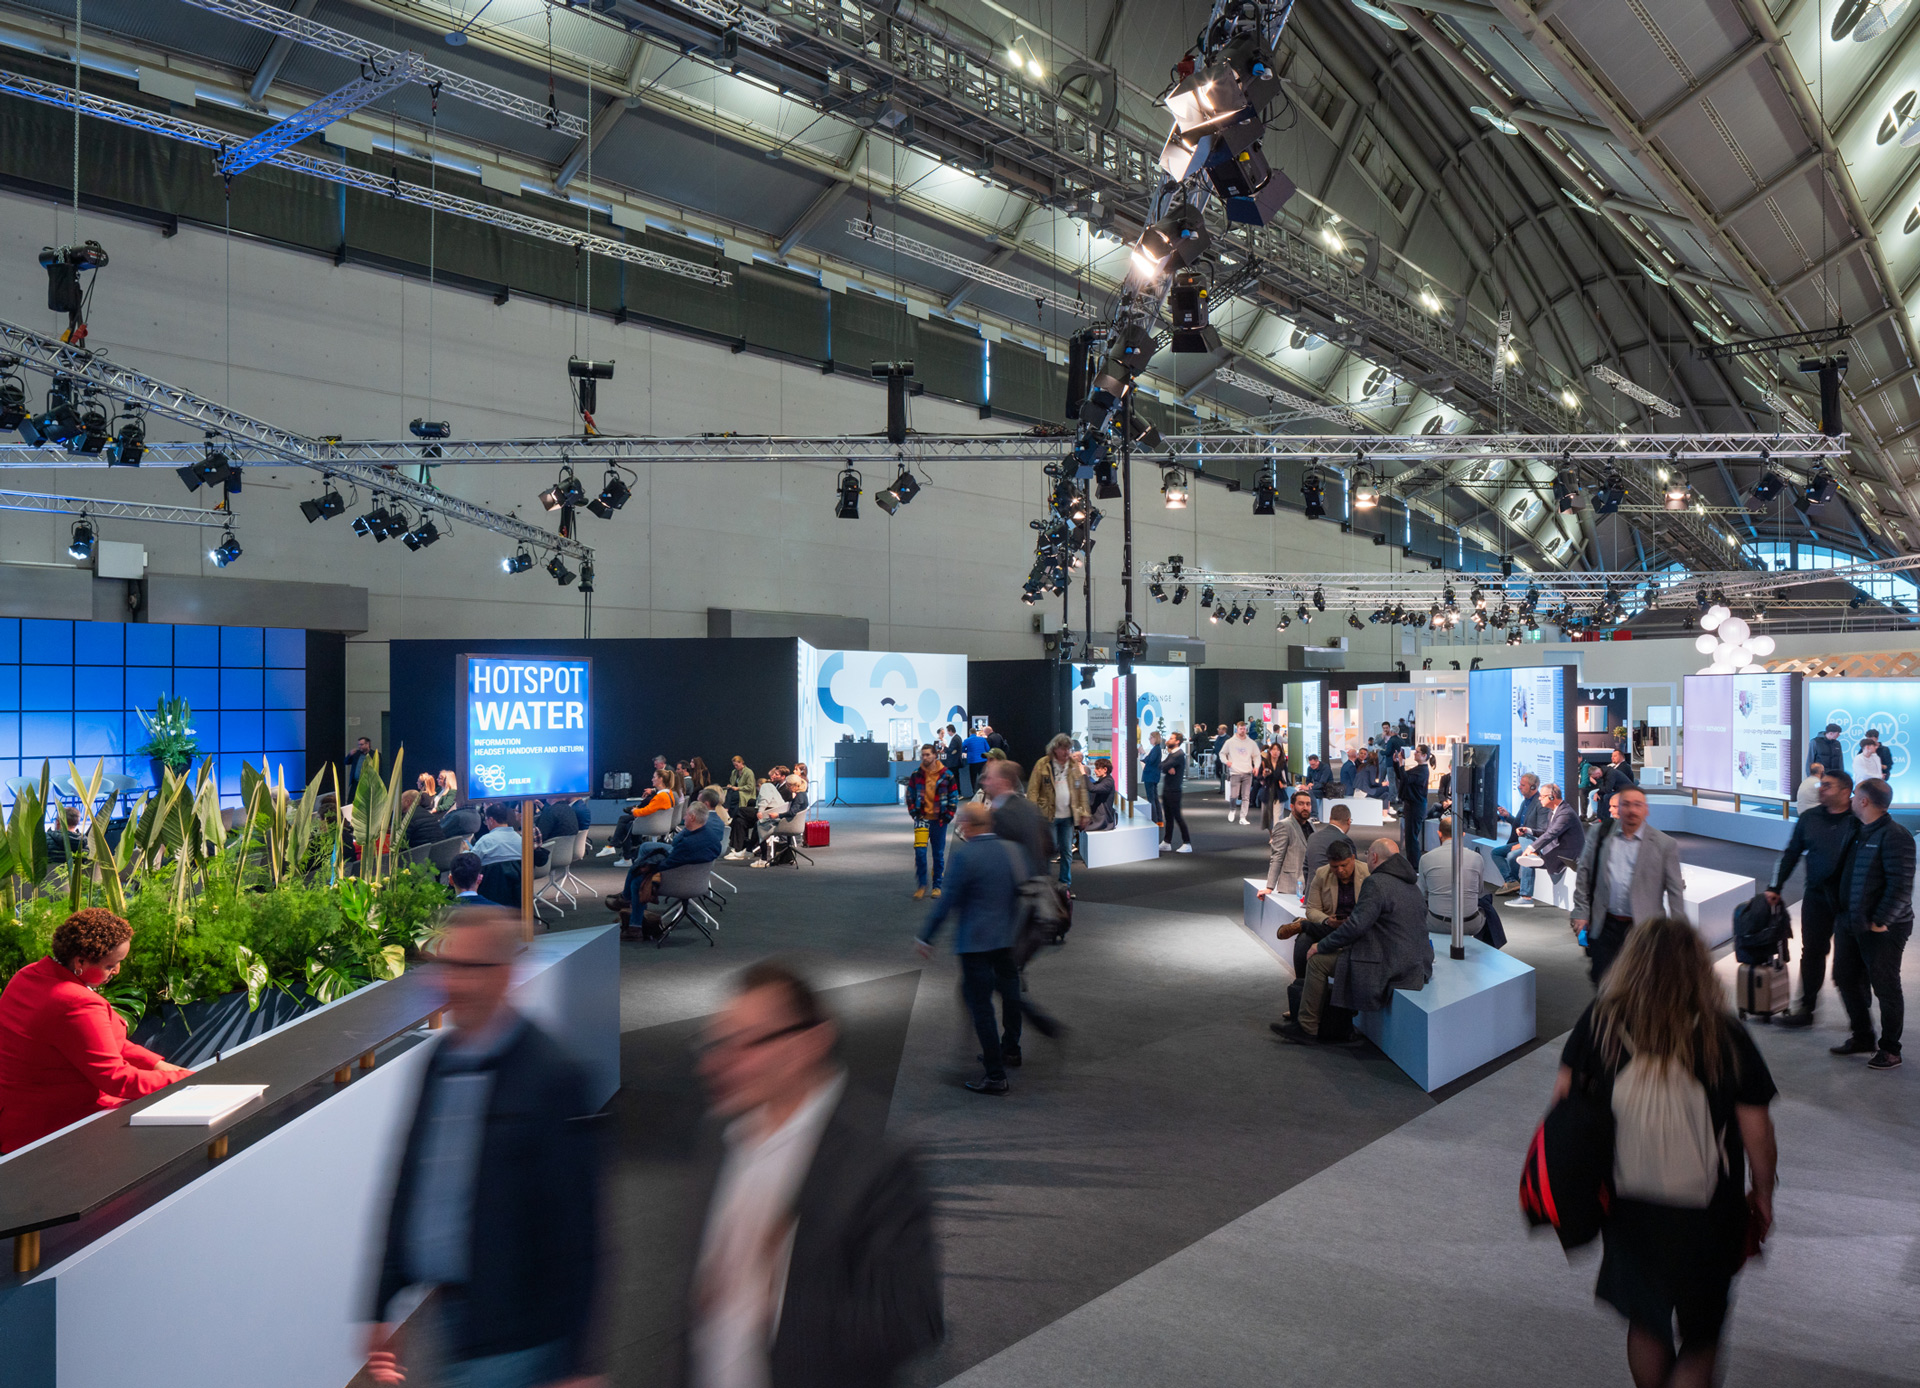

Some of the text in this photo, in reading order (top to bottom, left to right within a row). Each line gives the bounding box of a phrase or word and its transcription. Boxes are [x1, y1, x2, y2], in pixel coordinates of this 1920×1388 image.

[474, 666, 584, 694] HOTSPOT
[1148, 694, 1171, 702] LOUNGE
[475, 701, 584, 731] WATER
[1829, 718, 1849, 726] POP
[1870, 722, 1893, 735] MY
[474, 738, 521, 747] INFORMATION
[474, 745, 584, 756] HEADSET HANDOVER AND RETURN
[508, 777, 531, 785] ATELIER
